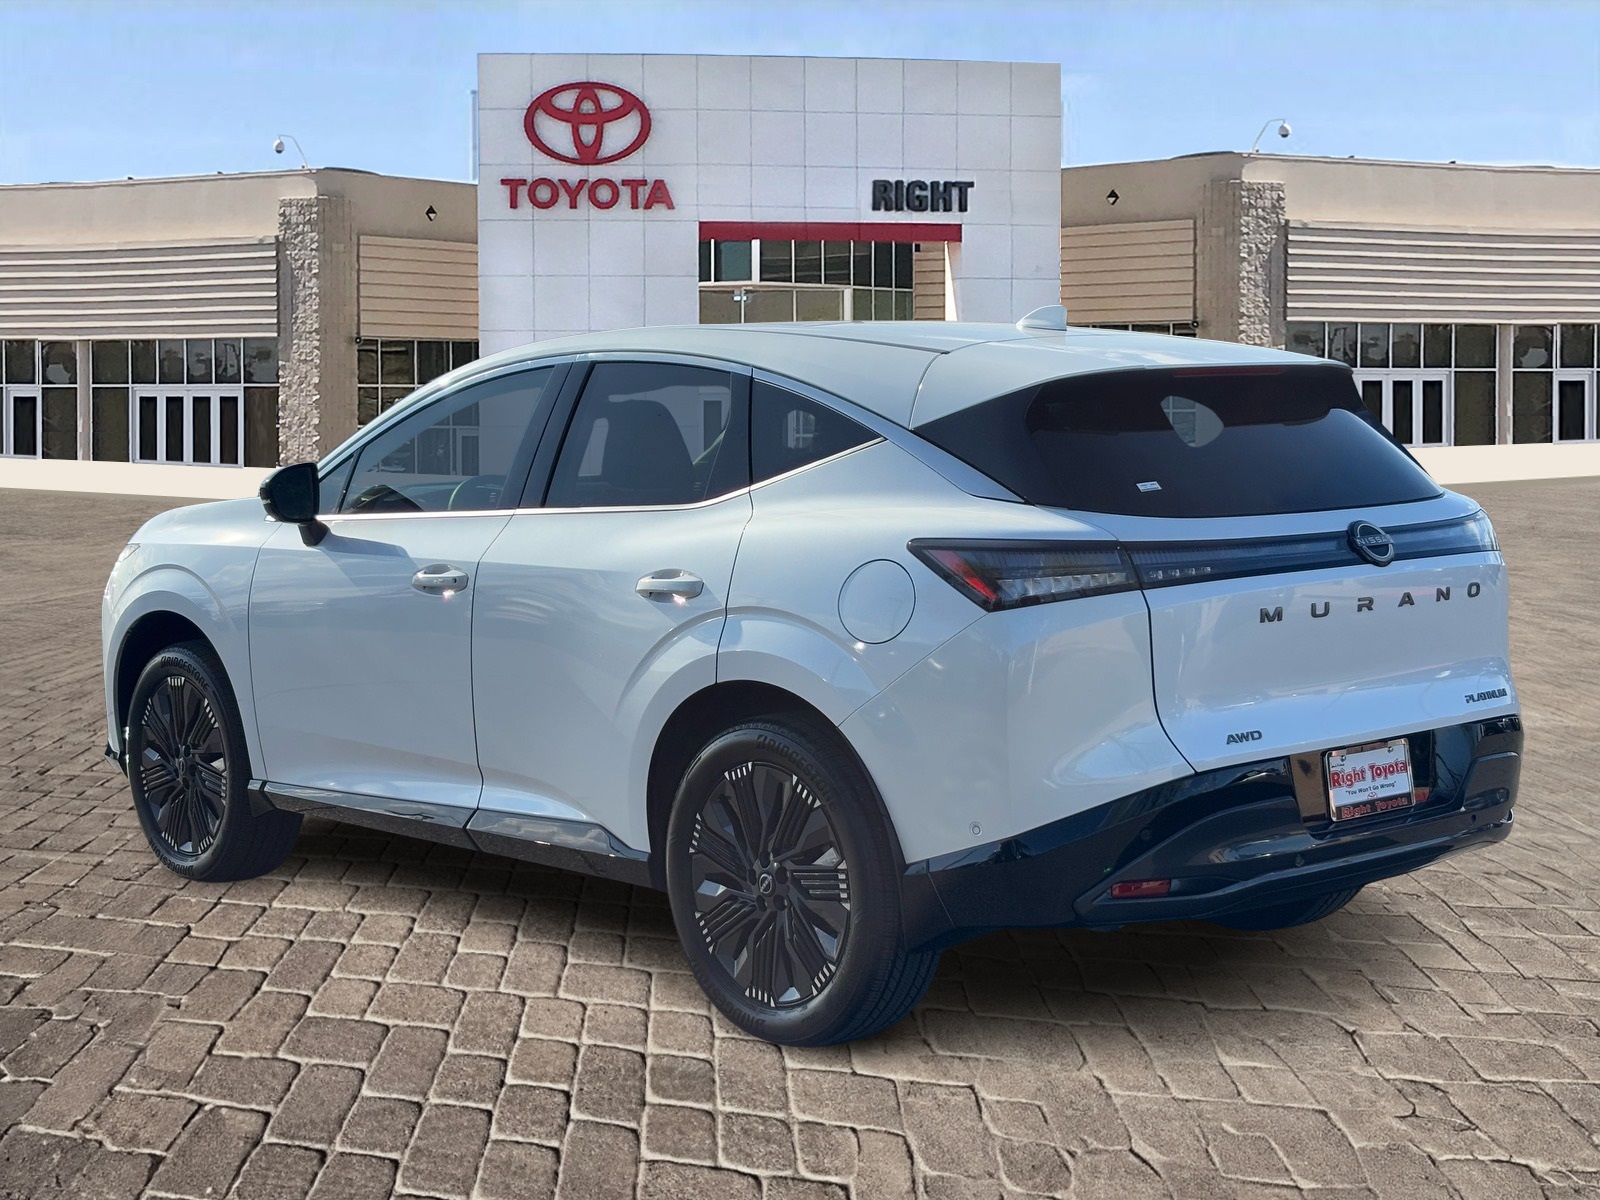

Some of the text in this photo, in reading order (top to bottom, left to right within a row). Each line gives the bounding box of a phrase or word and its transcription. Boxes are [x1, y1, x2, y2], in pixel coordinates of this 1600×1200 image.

[500, 178, 675, 210] TOYOTA
[871, 179, 975, 213] RIGHT
[1259, 581, 1481, 623] MURANO
[160, 656, 210, 691] BRIDGESTONE
[1464, 687, 1507, 704] PLATINUM
[1226, 729, 1263, 745] AWD
[1330, 758, 1408, 789] Right Toyota
[1358, 786, 1371, 794] Won't
[1341, 797, 1408, 818] Right Toyota
